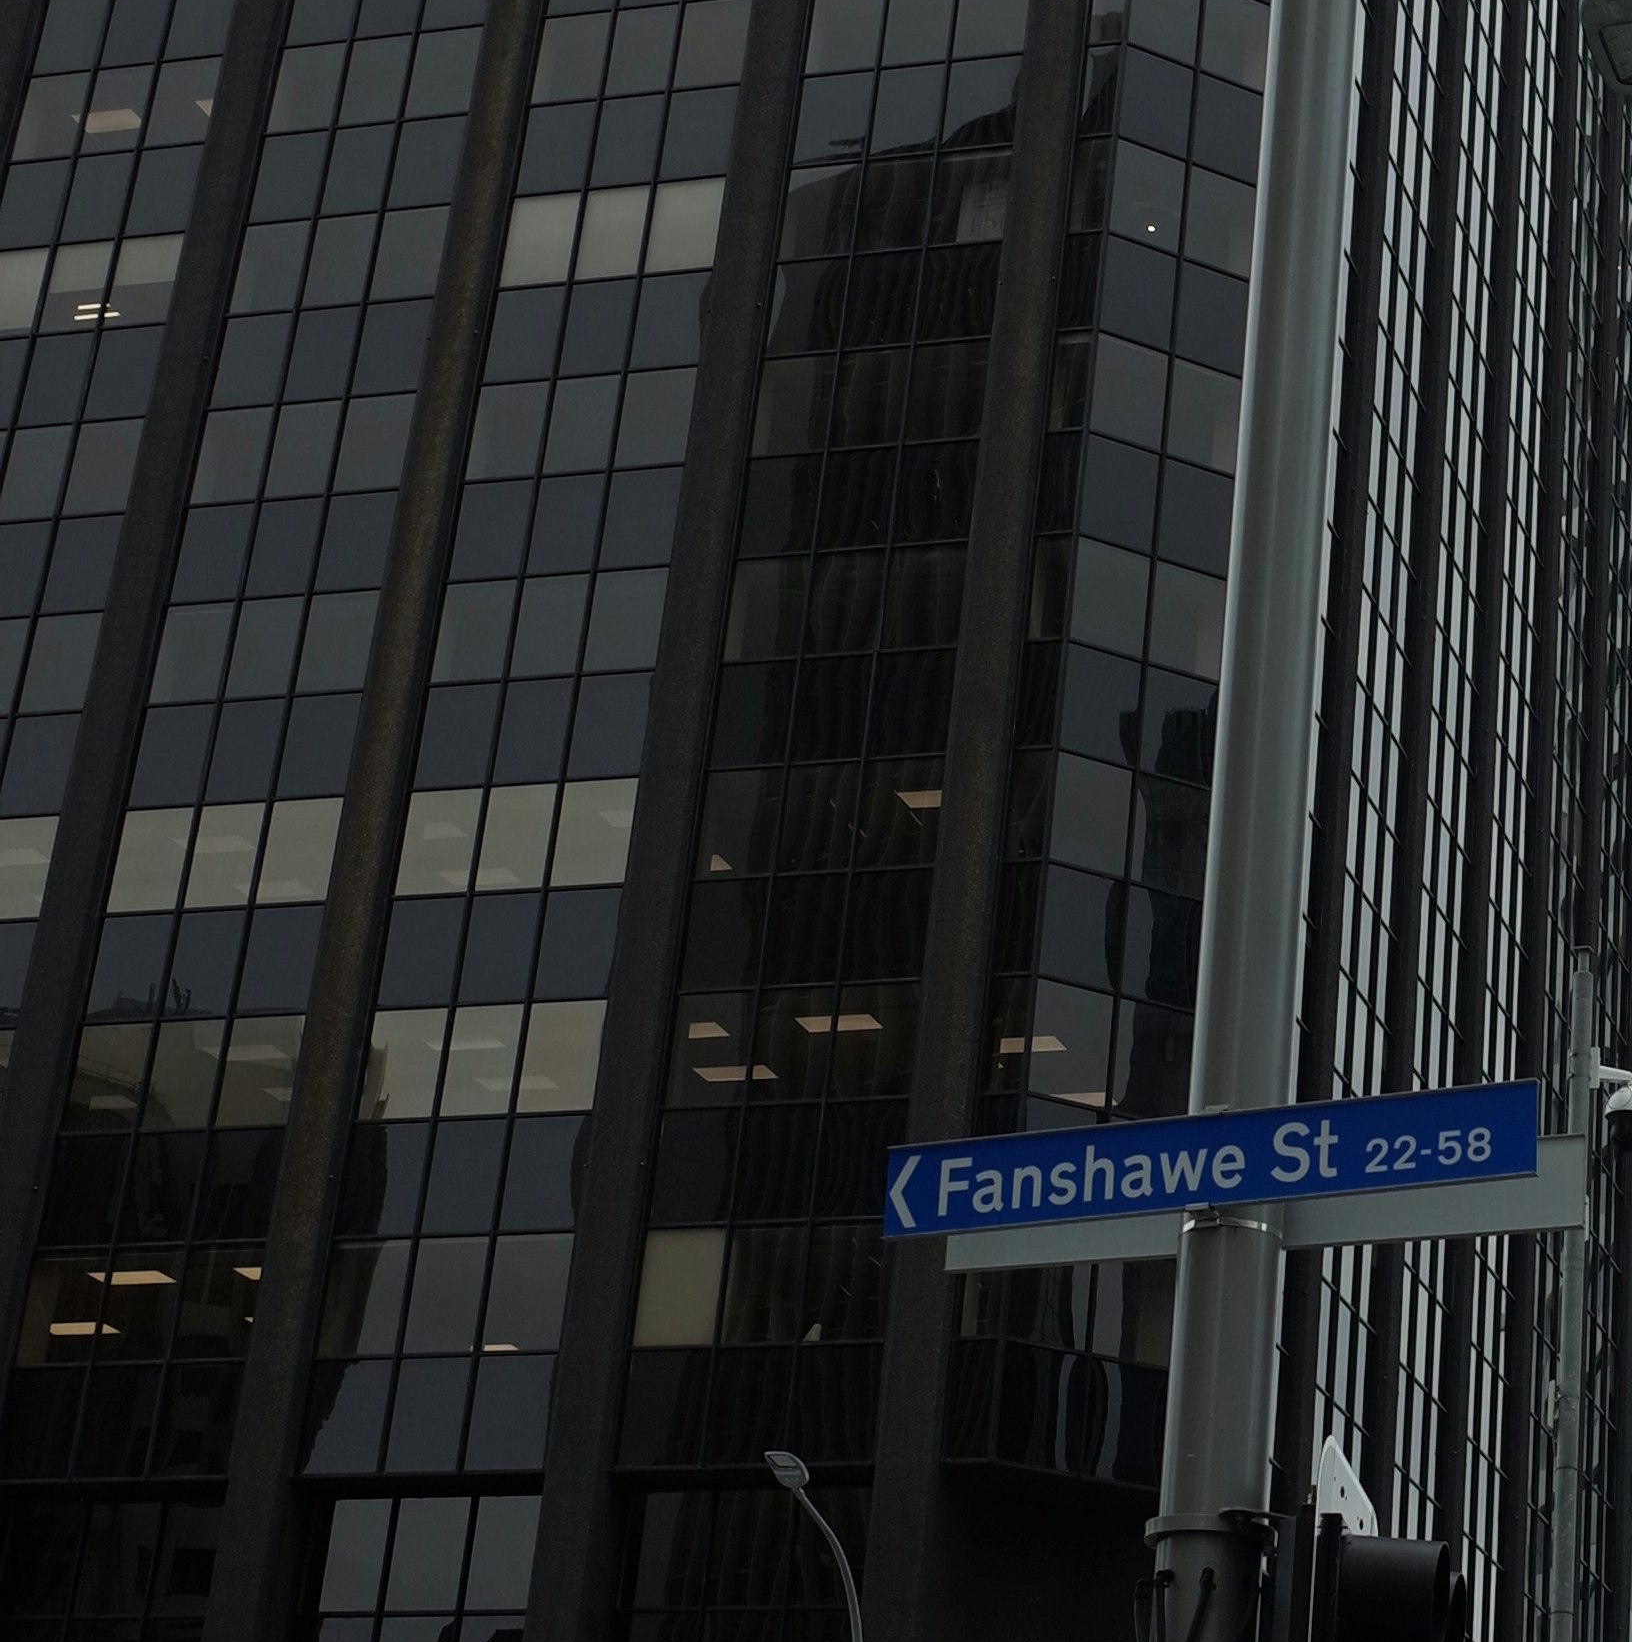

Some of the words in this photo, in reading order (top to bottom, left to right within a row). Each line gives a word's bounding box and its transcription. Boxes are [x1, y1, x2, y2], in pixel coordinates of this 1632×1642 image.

[937, 1144, 1245, 1217] Fanshawe
[1271, 1120, 1338, 1181] St
[1365, 1127, 1492, 1174] 22-58
